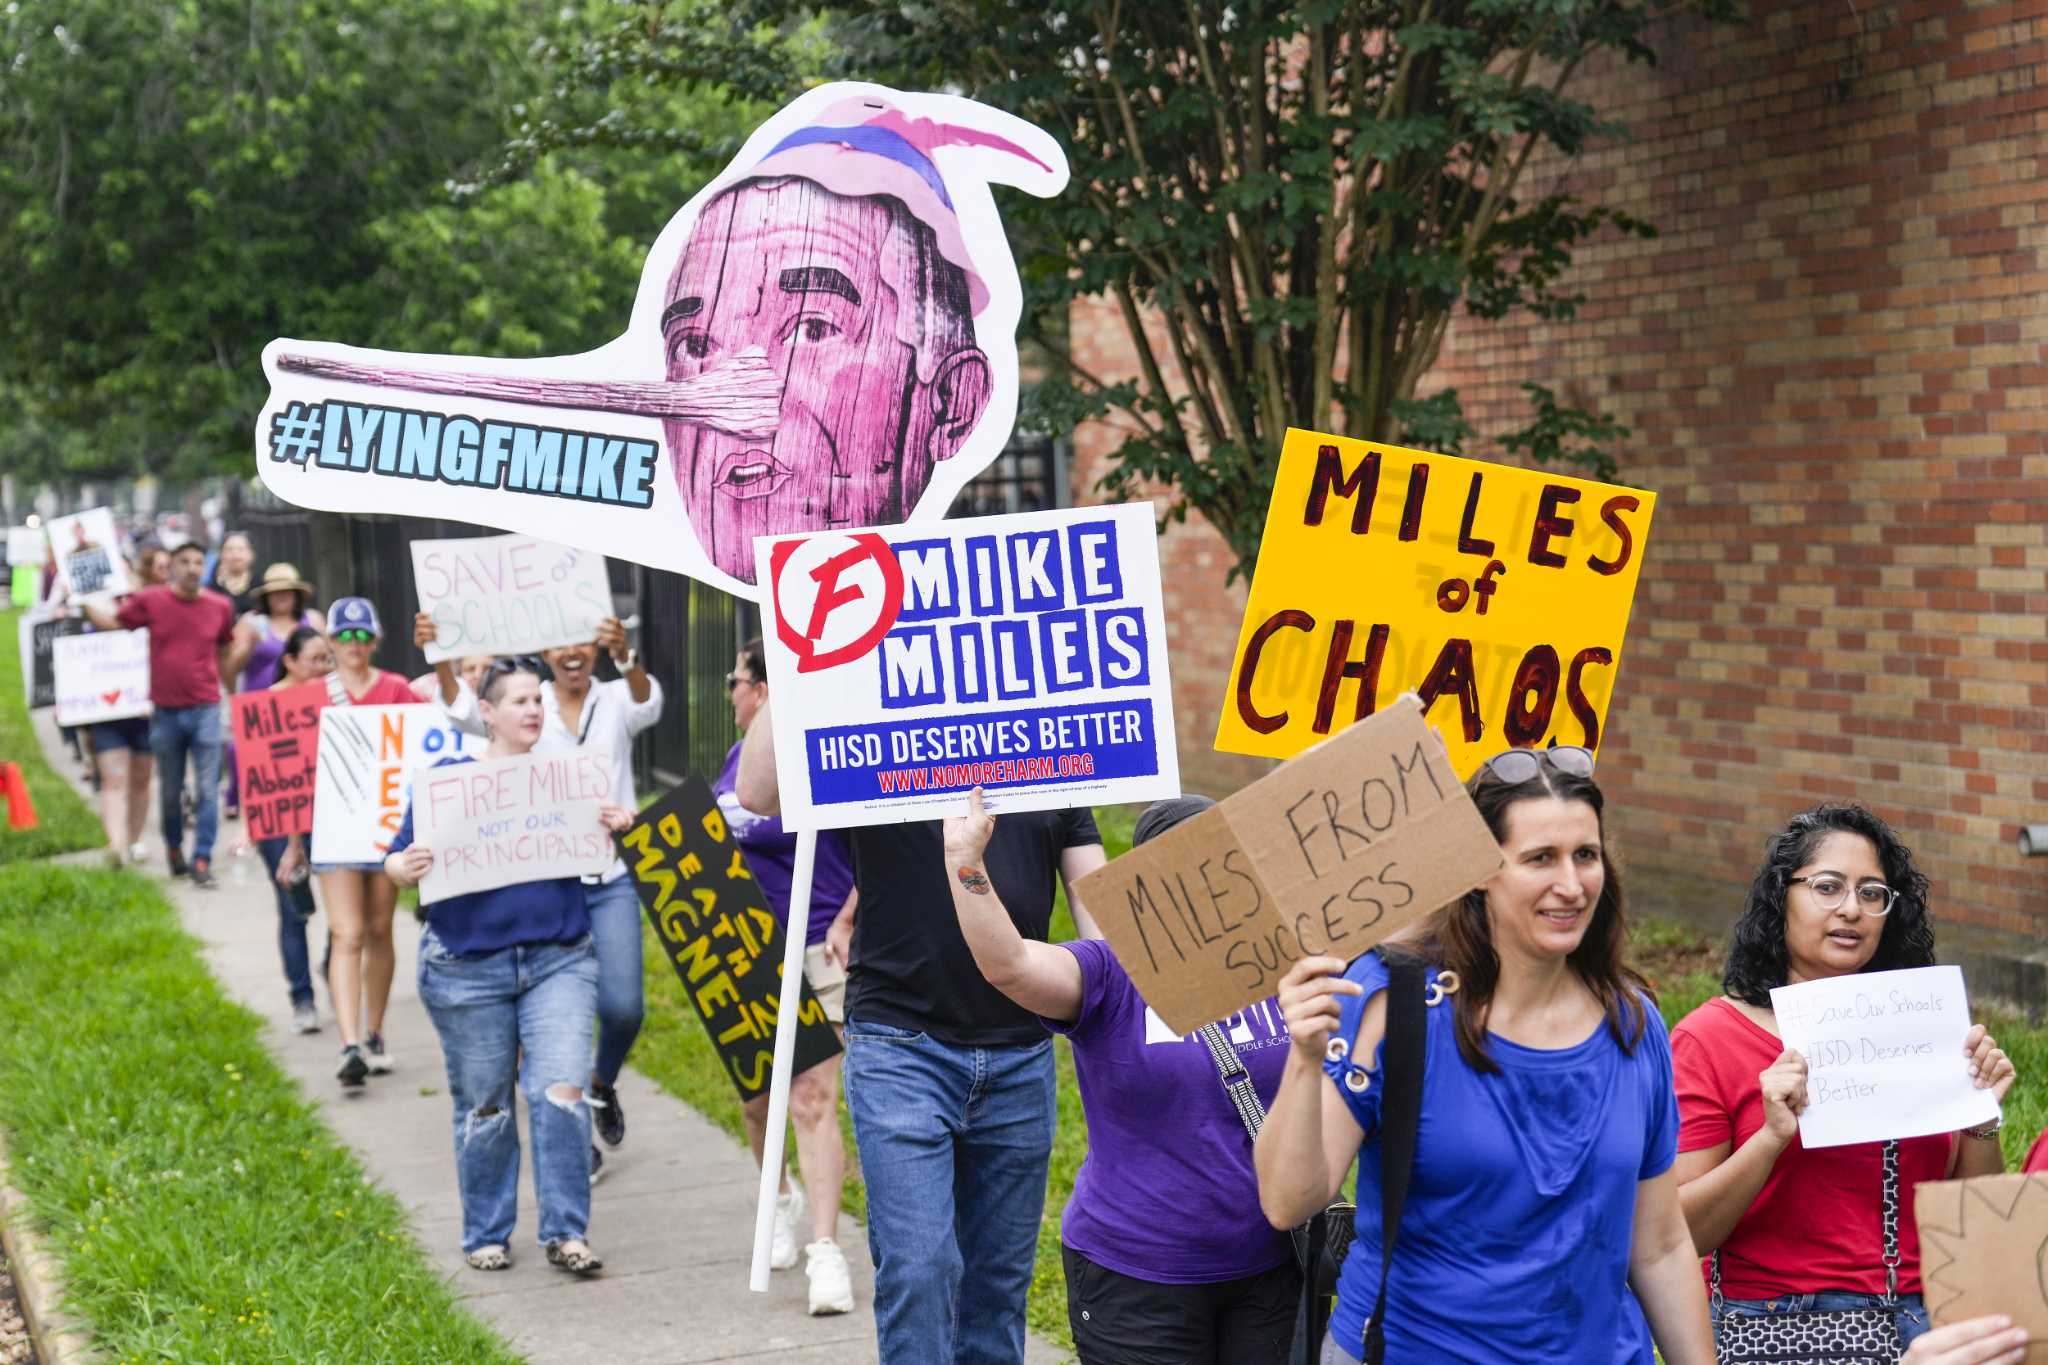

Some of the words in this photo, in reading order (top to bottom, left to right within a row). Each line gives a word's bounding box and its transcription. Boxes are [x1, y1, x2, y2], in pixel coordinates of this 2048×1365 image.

[269, 399, 659, 509] #LYINGFMIKE
[1304, 445, 1640, 576] MILES
[424, 543, 544, 600] SAVE
[898, 532, 1114, 611] MIKE
[1437, 560, 1506, 615] of
[433, 582, 602, 651] SCHOOLS
[884, 616, 1143, 699] MILES
[1237, 609, 1612, 752] CHAOS
[820, 732, 881, 770] HISD
[892, 720, 1029, 763] DESERVES
[1039, 710, 1142, 747] BETTER
[878, 753, 1094, 793] WWW.NOMOREHARM.ORG
[245, 795, 314, 839] PUPP
[428, 768, 518, 830] FIRE
[529, 753, 612, 806] MILES
[478, 819, 515, 839] NOT
[525, 811, 568, 829] OUR
[658, 812, 752, 978] DEATH
[1126, 849, 1261, 974] MILES
[1286, 742, 1444, 880] FROM
[702, 808, 825, 1027] DYAS
[1226, 862, 1414, 989] SUCCESS
[622, 823, 775, 1091] MAGNETS
[1234, 1040, 1263, 1053] IDDLE
[1860, 1037, 1934, 1066] Deserves
[1814, 1077, 1880, 1105] Better
